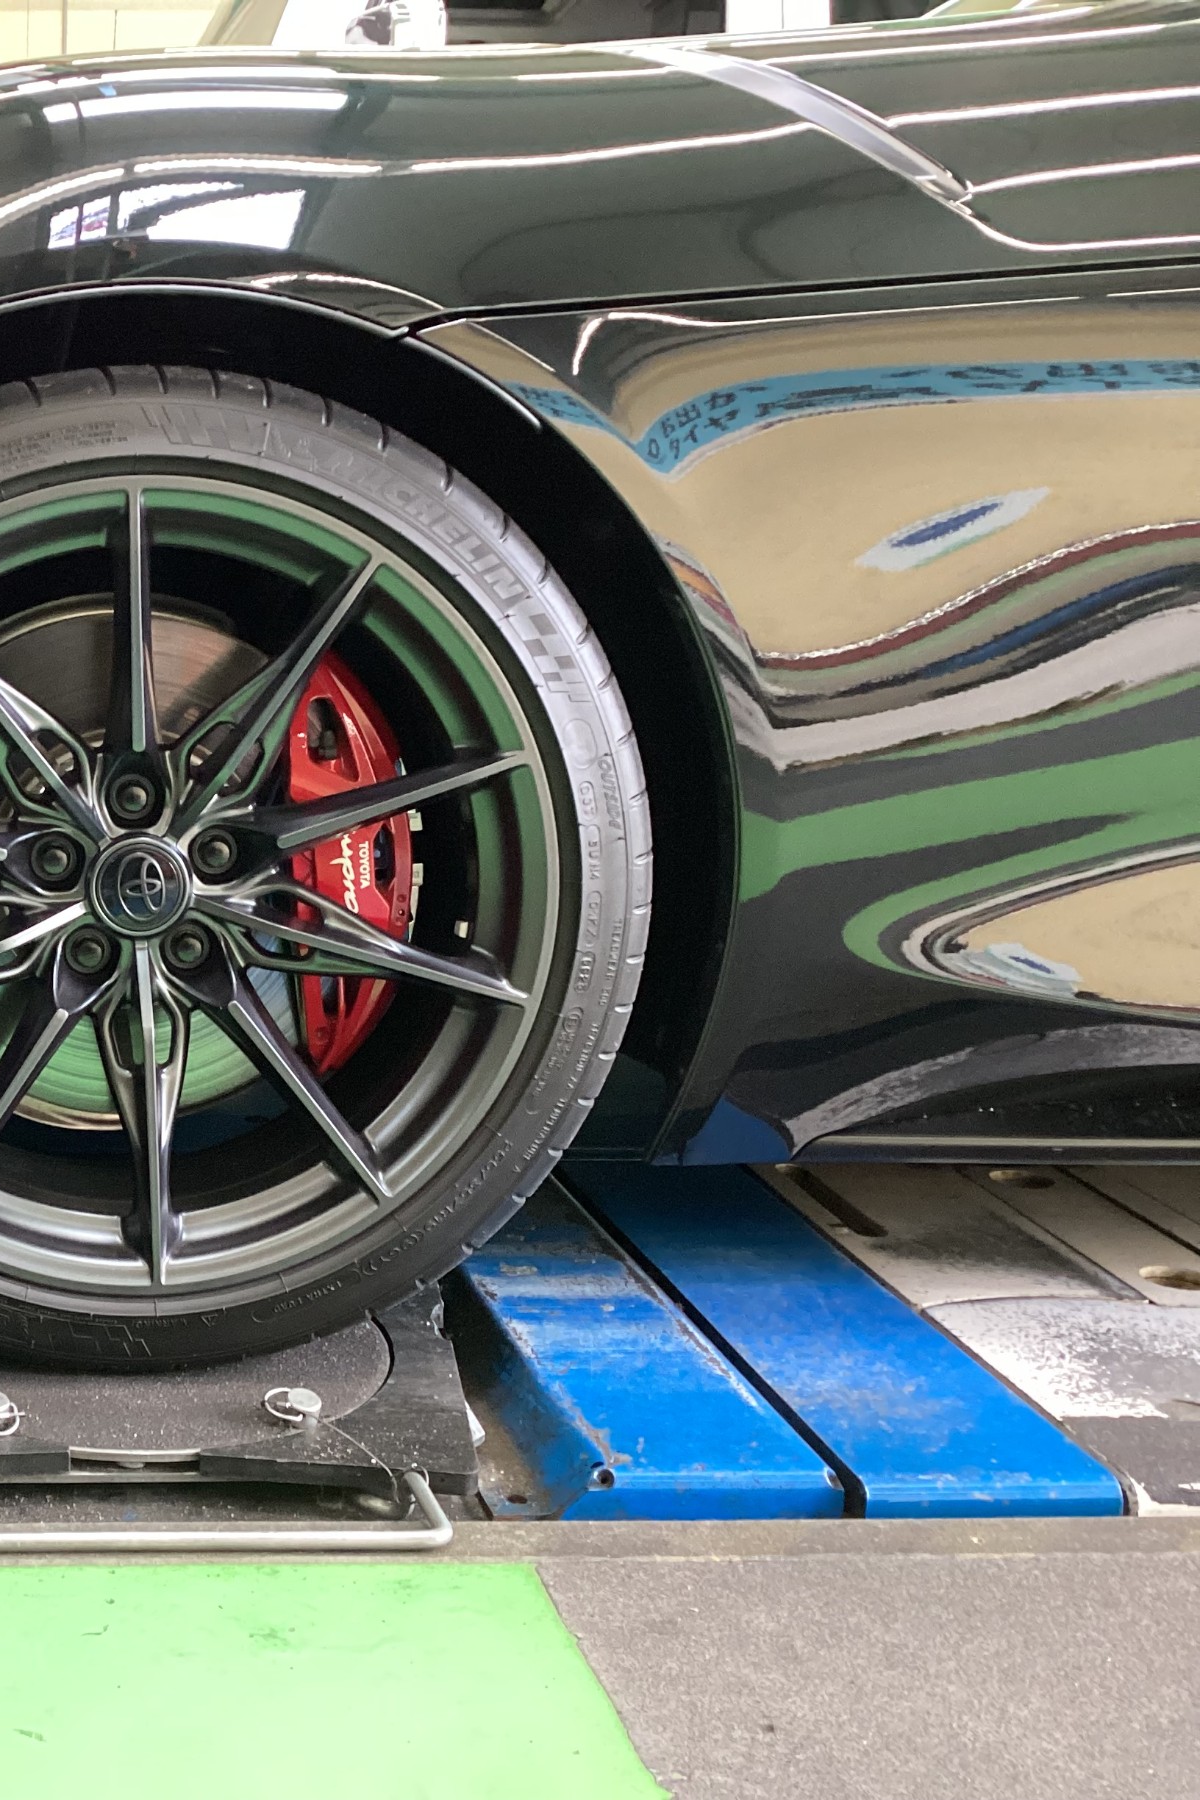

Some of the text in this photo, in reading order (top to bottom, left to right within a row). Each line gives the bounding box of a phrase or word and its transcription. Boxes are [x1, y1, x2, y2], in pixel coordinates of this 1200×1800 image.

[318, 447, 526, 602] MICHELIN
[329, 831, 359, 914] upra
[358, 840, 370, 889] TOYOTA
